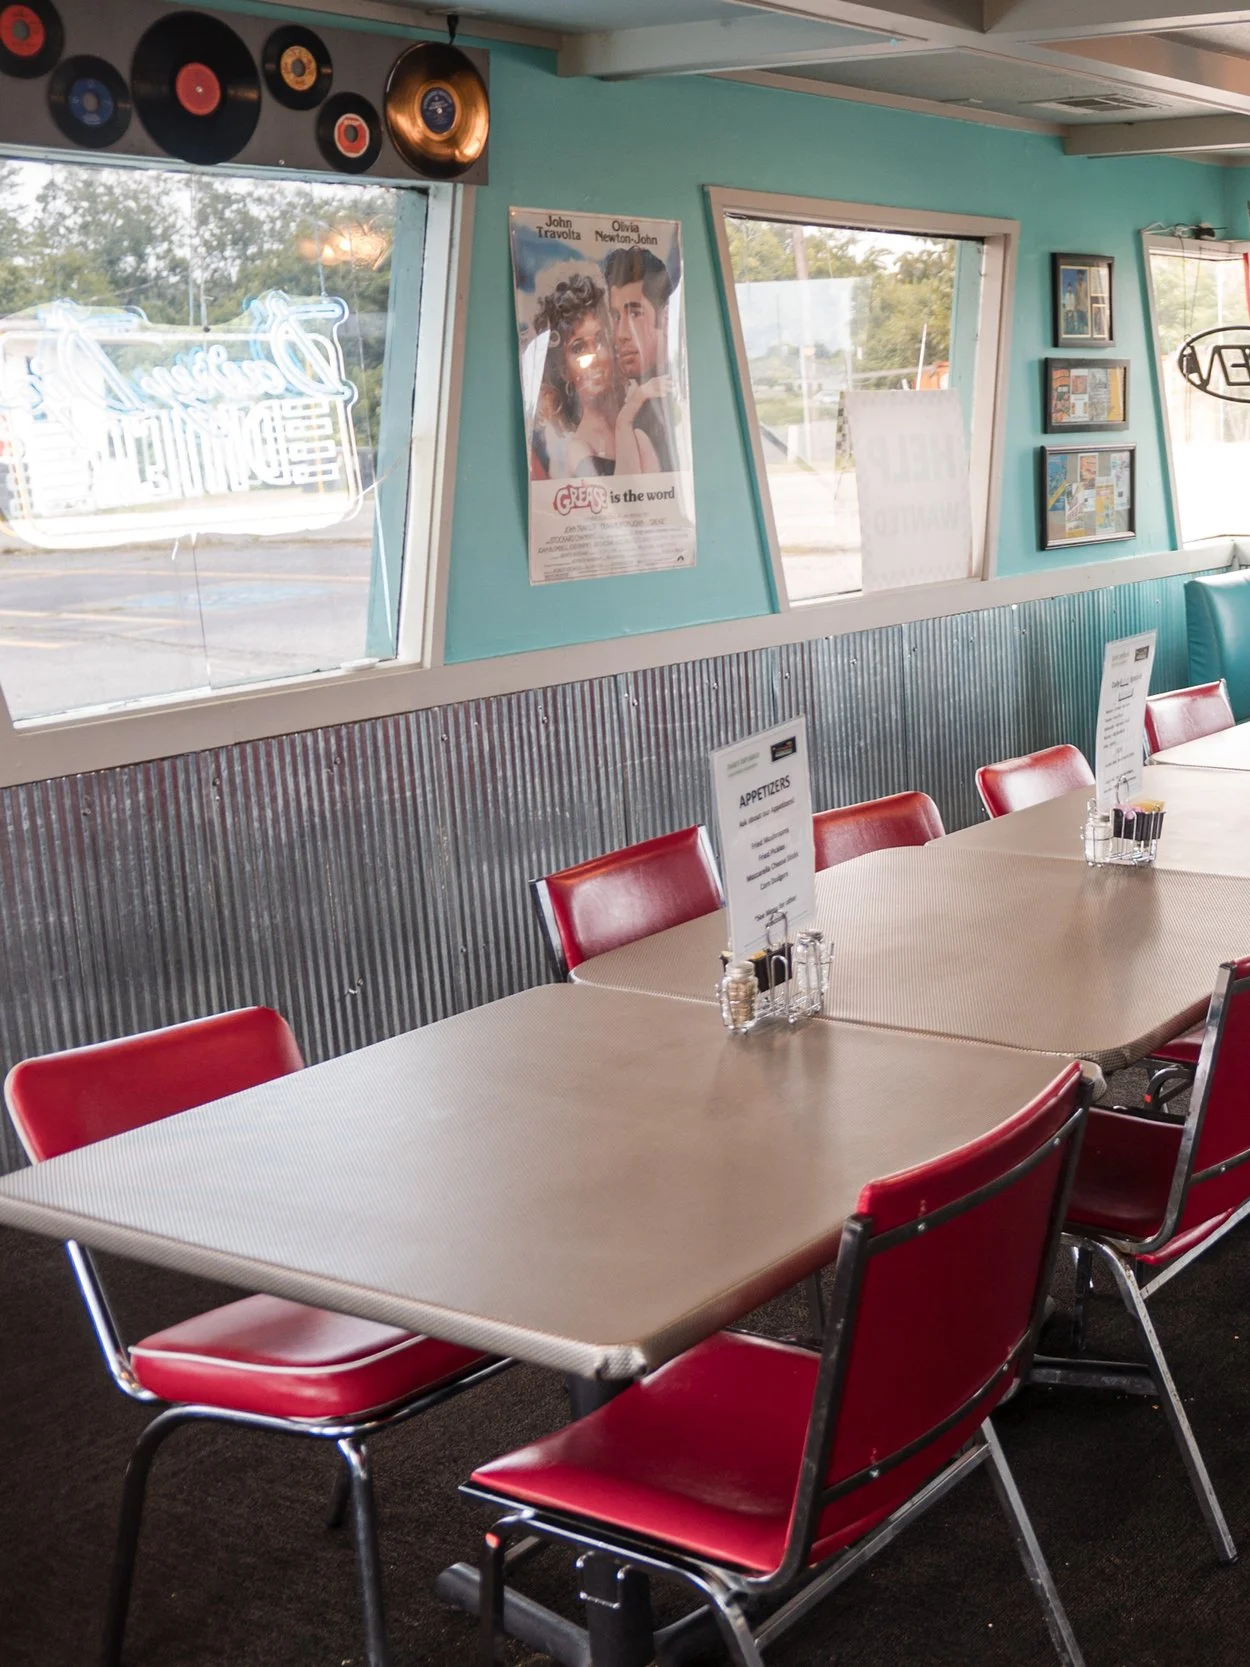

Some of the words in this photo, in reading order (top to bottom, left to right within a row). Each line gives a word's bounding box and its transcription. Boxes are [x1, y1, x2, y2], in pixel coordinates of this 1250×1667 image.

[545, 216, 573, 229] John
[611, 220, 640, 234] Olivia
[536, 226, 582, 241] Travolta
[594, 230, 659, 246] Newton-John
[553, 483, 608, 515] GREASE
[610, 489, 621, 504] is
[622, 488, 646, 503] the
[647, 485, 676, 502] word
[739, 775, 791, 809] APPETIZERS
